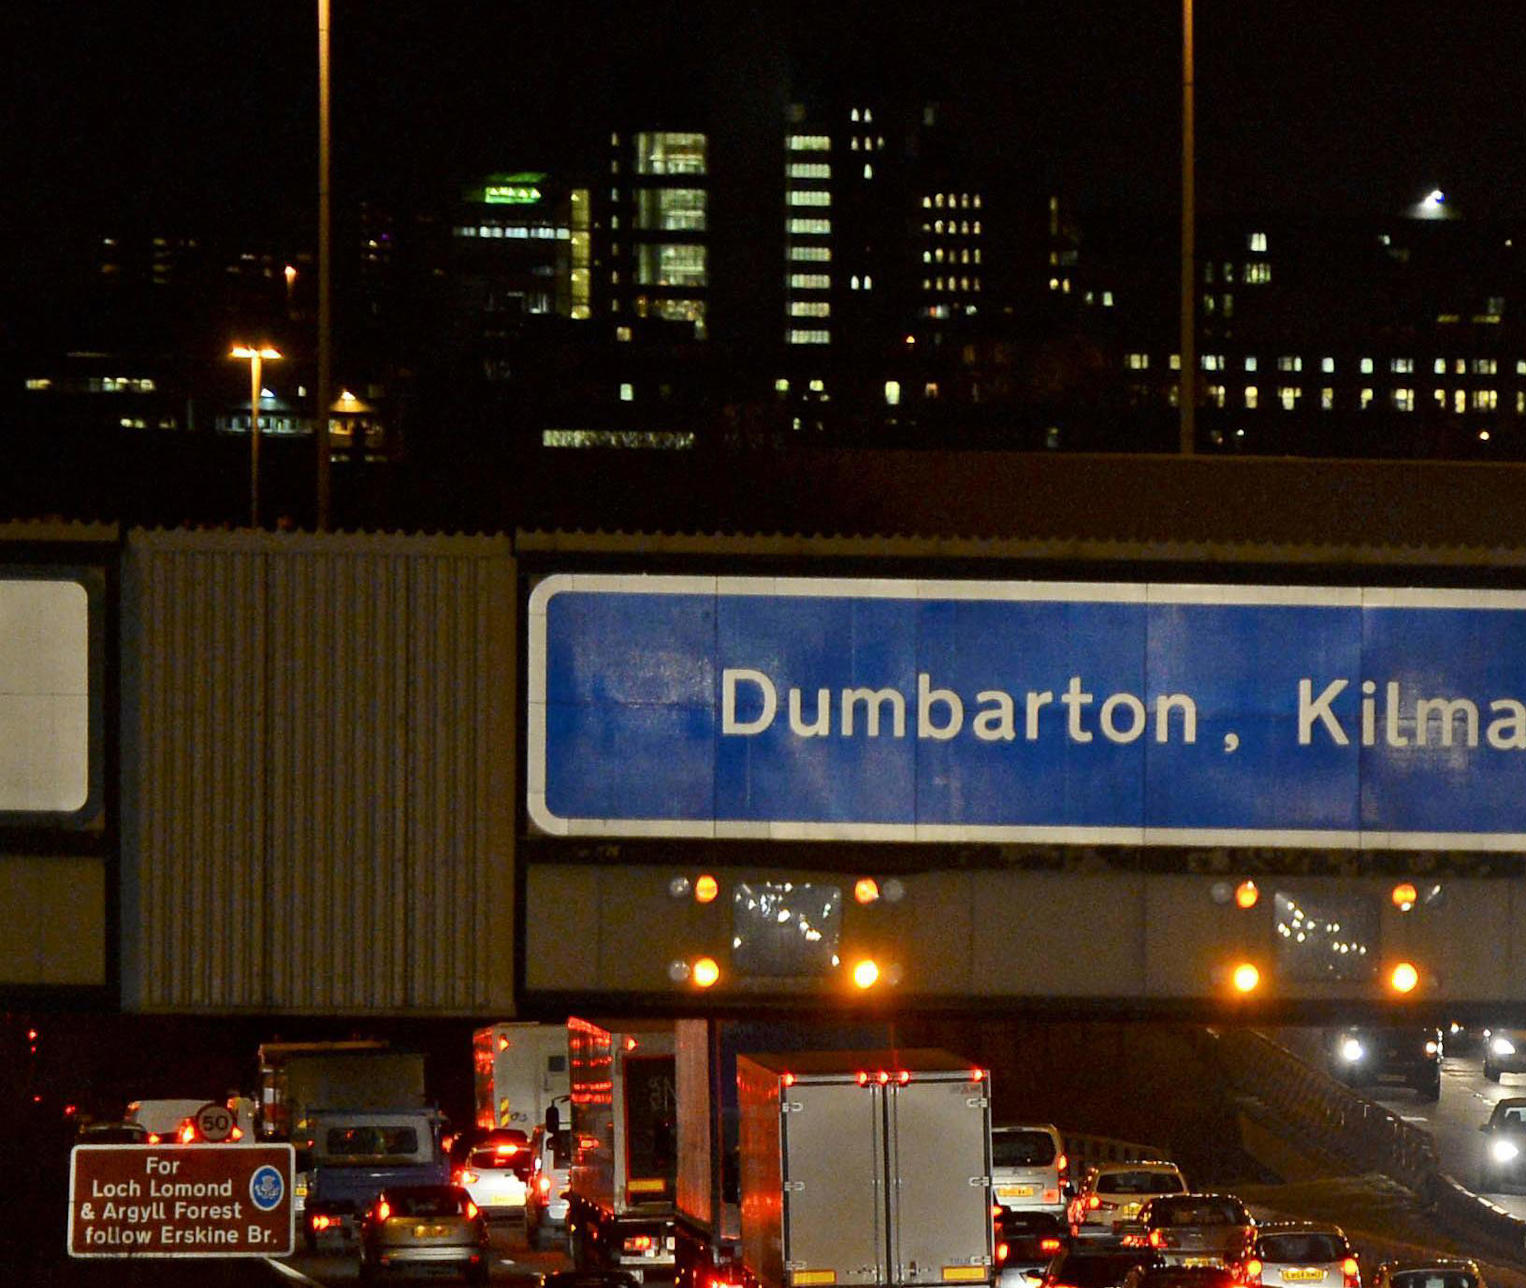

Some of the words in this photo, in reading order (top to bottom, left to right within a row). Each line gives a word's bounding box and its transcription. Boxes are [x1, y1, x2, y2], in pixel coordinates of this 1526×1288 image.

[722, 668, 1239, 752] Dumbarton,
[202, 1115, 229, 1131] 50
[146, 1156, 180, 1174] For
[92, 1179, 141, 1197] Loch
[150, 1178, 232, 1197] Lomond
[80, 1202, 95, 1220] &
[102, 1202, 166, 1223] Argyll
[174, 1202, 242, 1220] Forest
[85, 1226, 152, 1244] follow
[160, 1225, 239, 1244] Erskine
[247, 1225, 278, 1244] Br.
